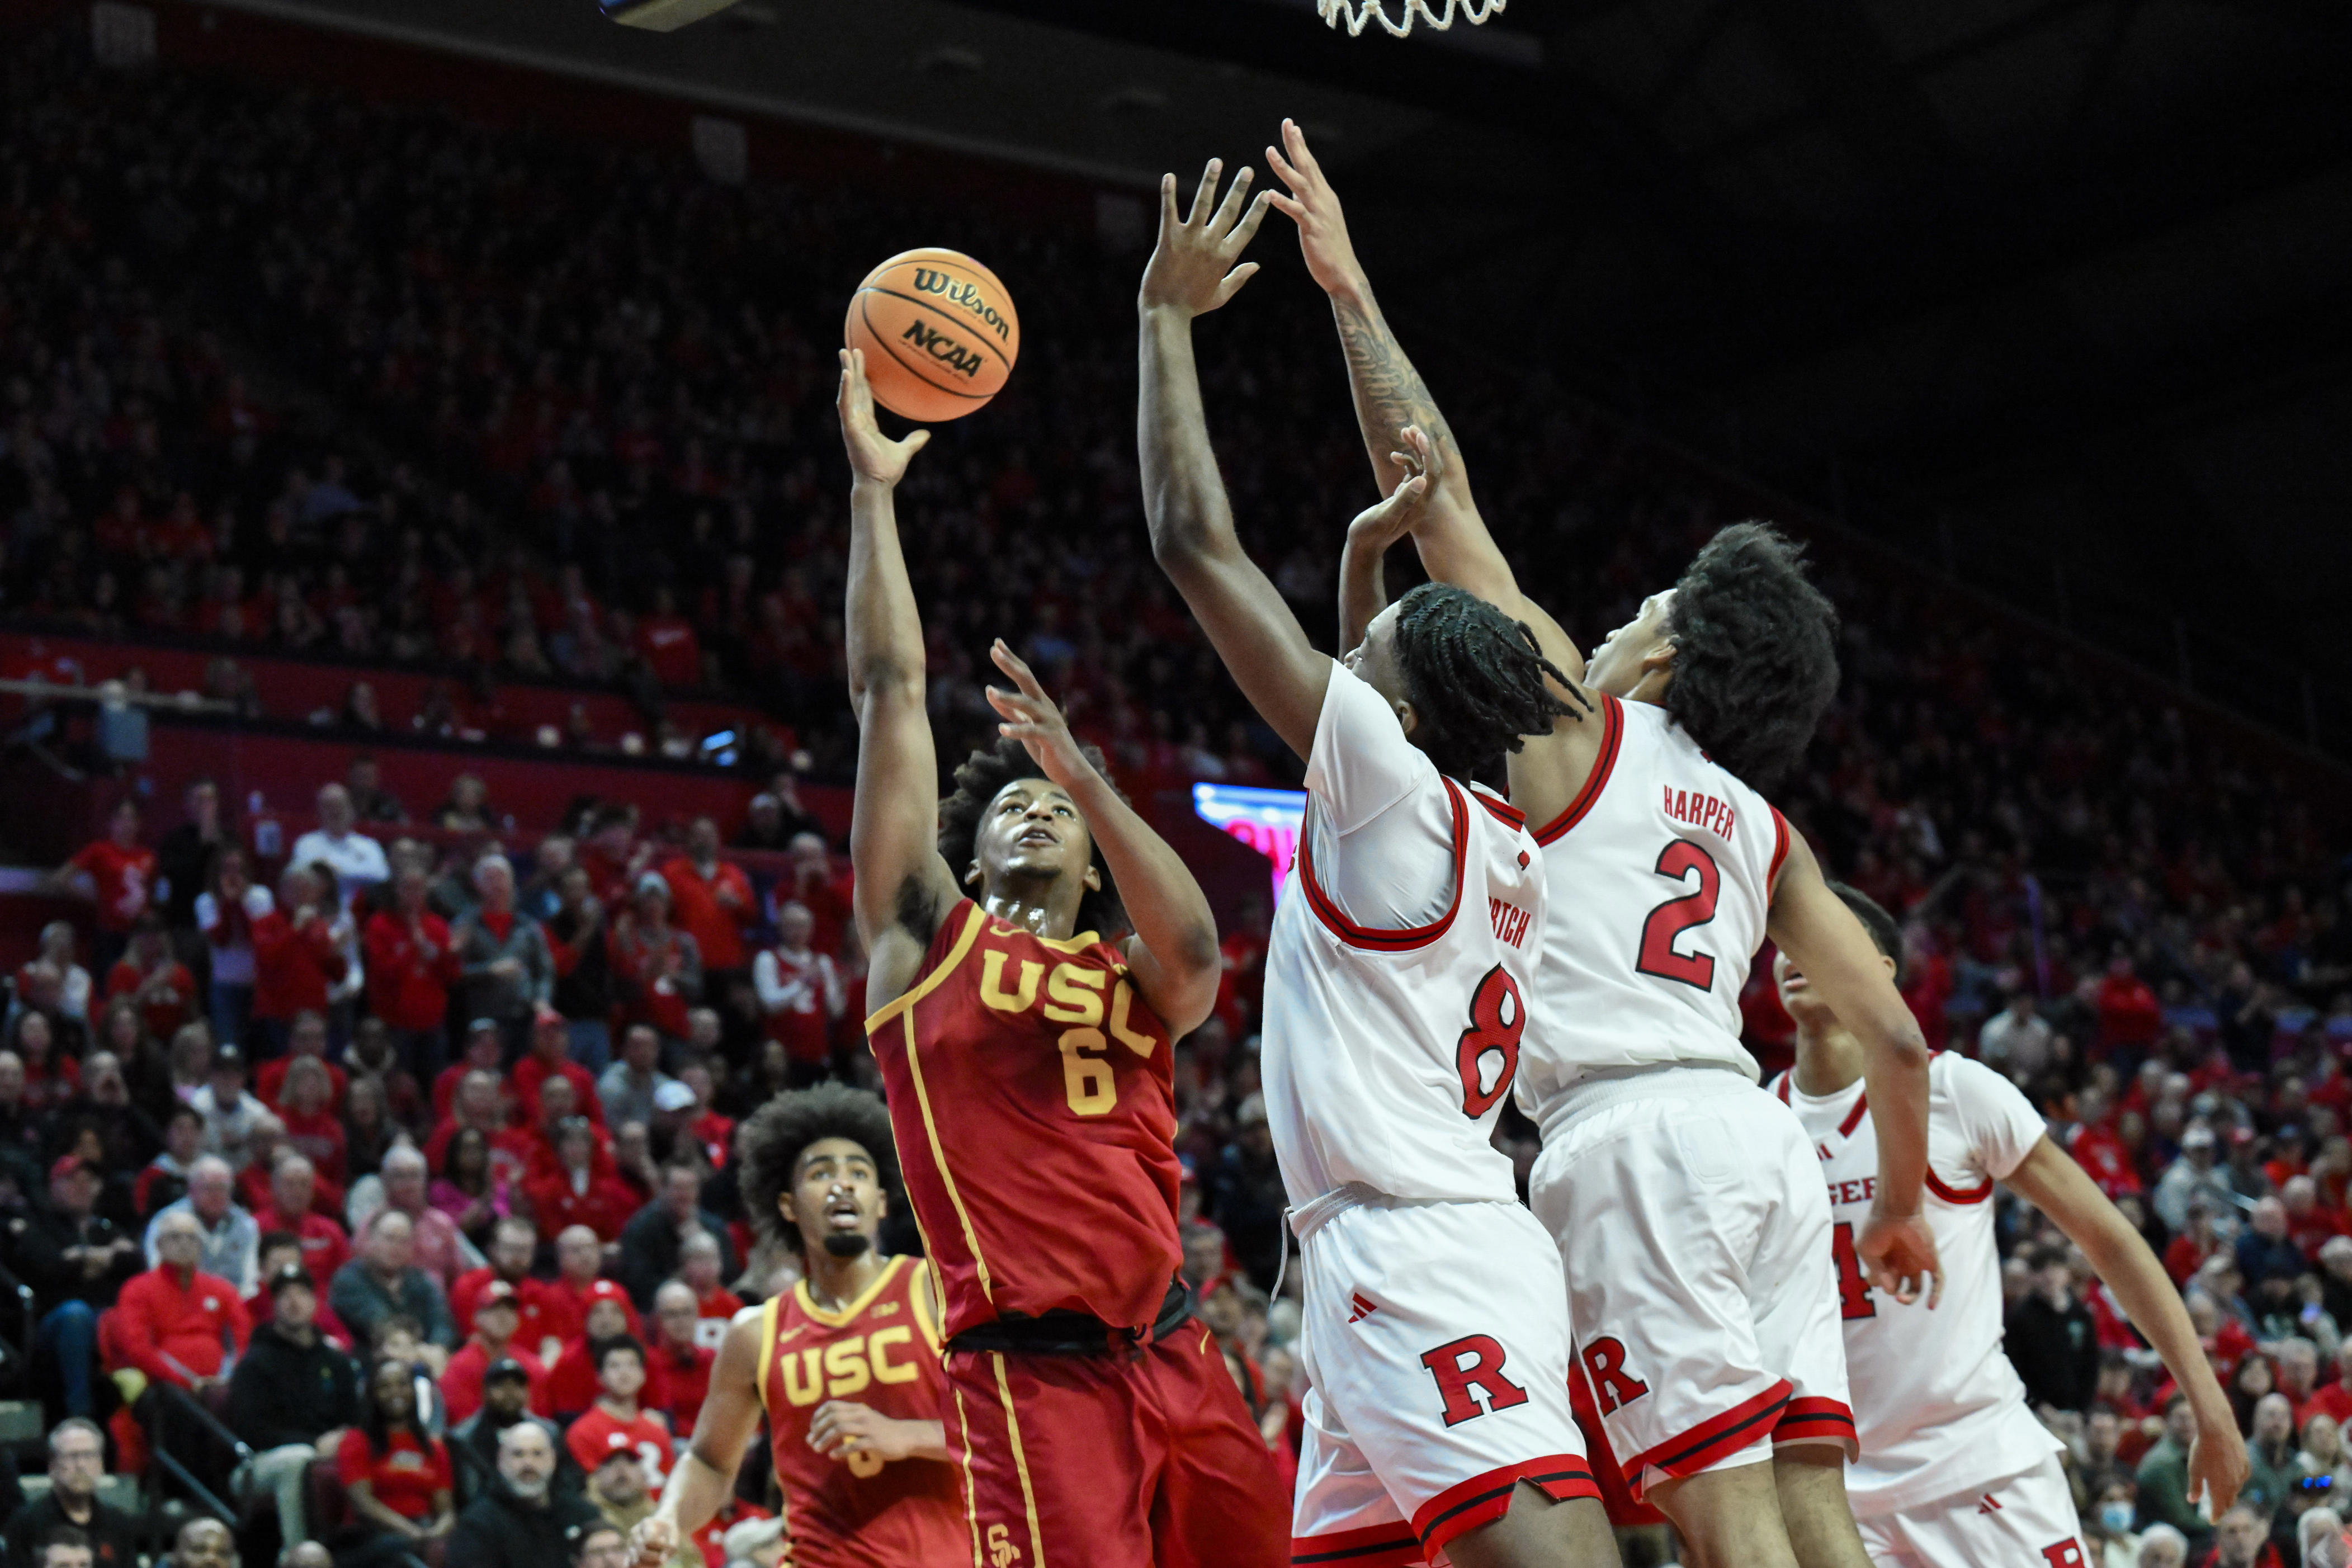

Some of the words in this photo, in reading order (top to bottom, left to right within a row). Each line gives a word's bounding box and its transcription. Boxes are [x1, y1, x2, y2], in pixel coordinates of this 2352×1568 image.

[914, 268, 1009, 342] Wilson
[902, 319, 984, 377] NCAA
[1664, 784, 1735, 842] HARPER
[1488, 896, 1531, 950] RTCH
[1636, 838, 1721, 993] 2
[1058, 1027, 1117, 1116] 6
[1456, 961, 1526, 1120] 8
[781, 1325, 919, 1406] USC
[1420, 1334, 1529, 1428] R
[1582, 1336, 1649, 1418] R
